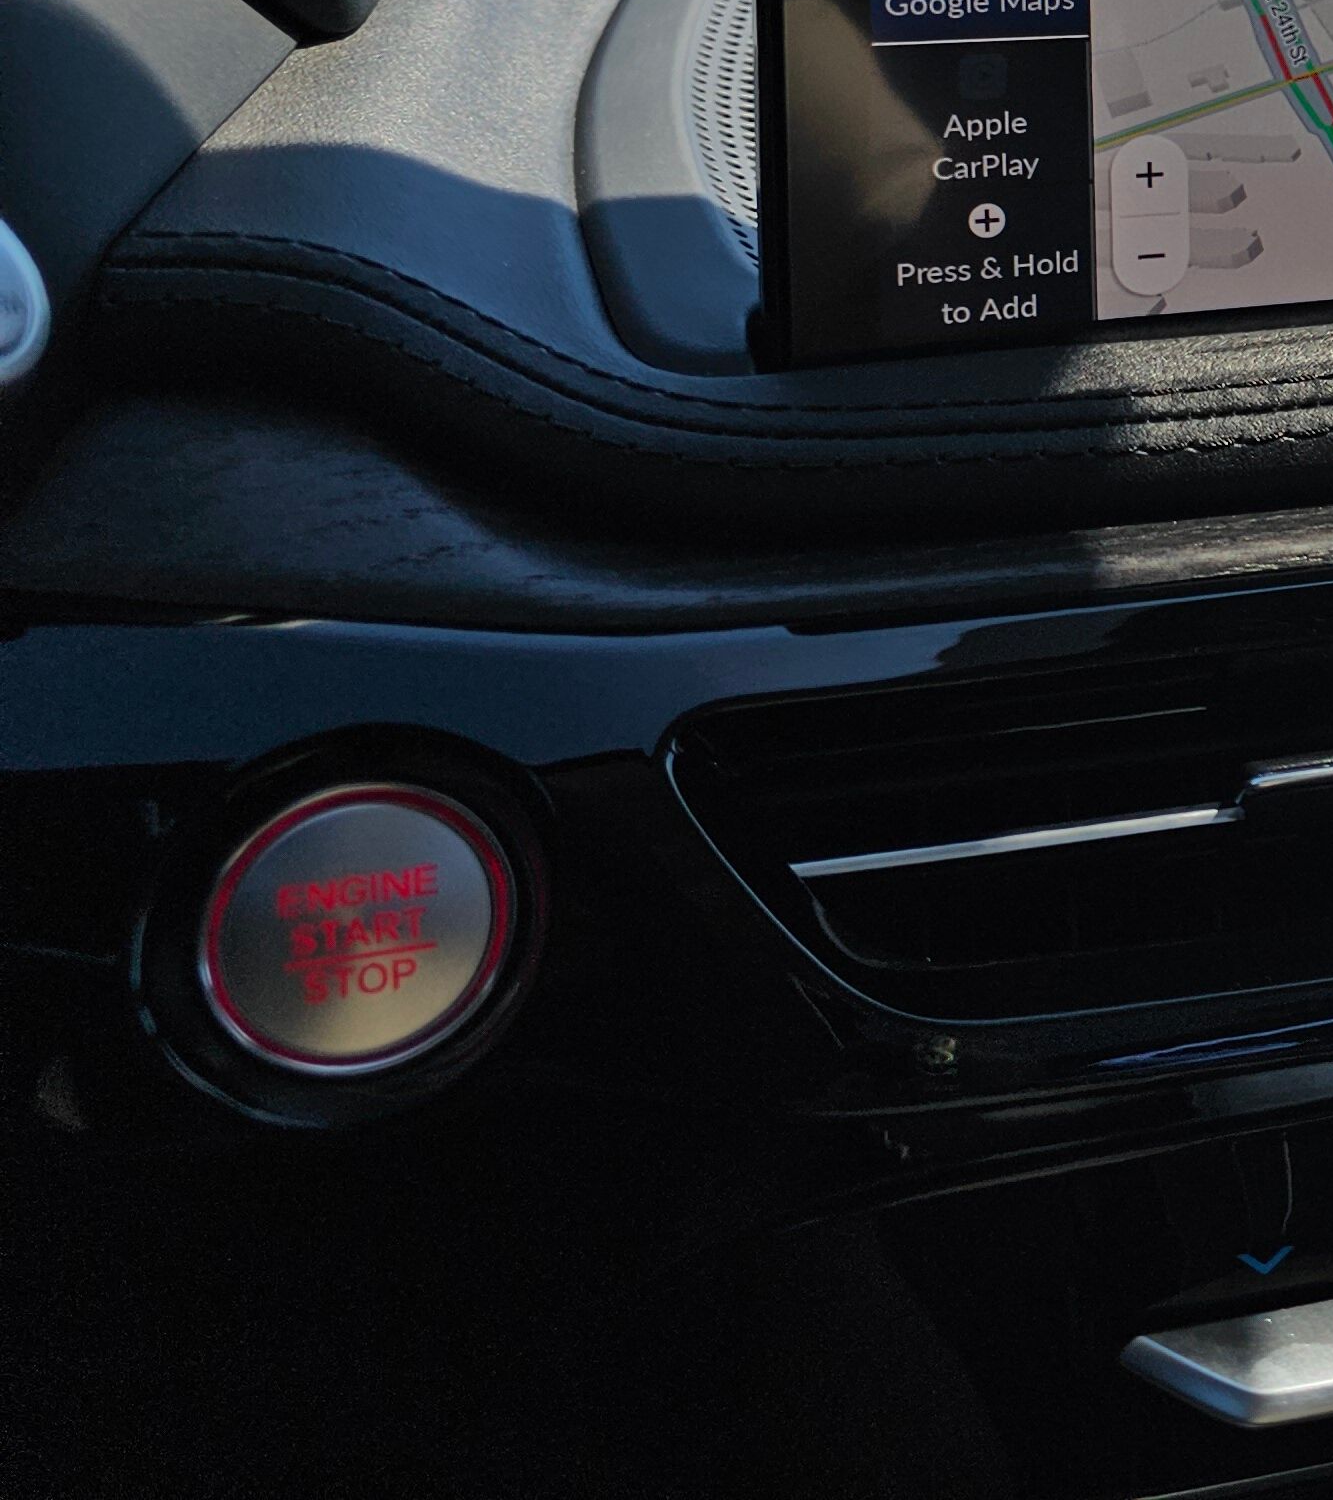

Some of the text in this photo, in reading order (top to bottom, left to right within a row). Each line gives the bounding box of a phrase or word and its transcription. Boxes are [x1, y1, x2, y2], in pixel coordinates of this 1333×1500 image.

[1270, 2, 1299, 46] 24th
[1290, 44, 1309, 66] St
[943, 111, 1028, 141] Apple
[932, 153, 1041, 181] CarPlay
[897, 249, 1080, 287] Press & Hold
[941, 294, 1038, 325] to Add
[276, 862, 439, 919] ENGINE
[291, 905, 428, 954] START
[304, 957, 417, 1006] STOP
